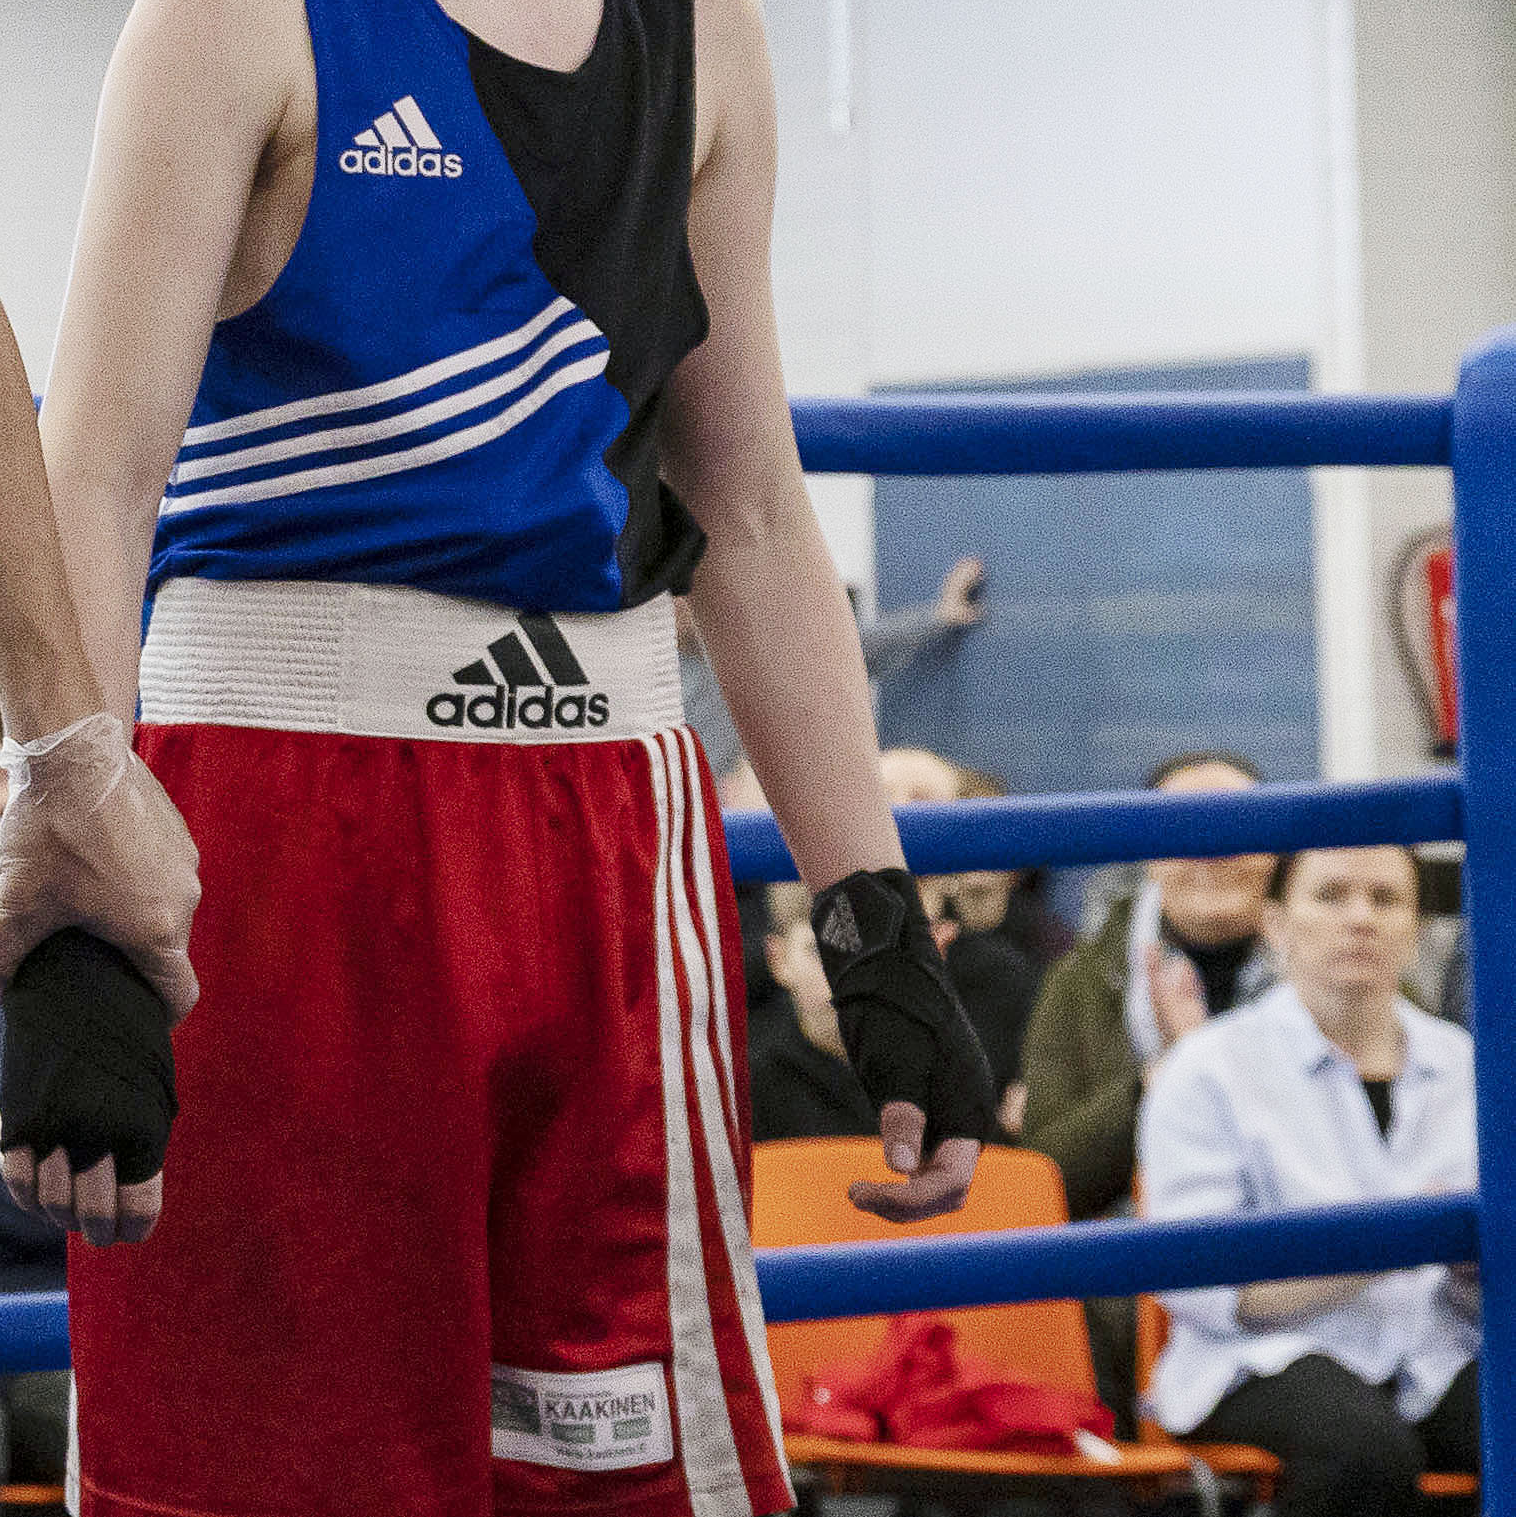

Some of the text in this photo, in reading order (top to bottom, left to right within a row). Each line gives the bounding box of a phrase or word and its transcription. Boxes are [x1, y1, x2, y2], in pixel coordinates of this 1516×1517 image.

[339, 146, 464, 179] adidas
[426, 684, 610, 729] adidas
[544, 1391, 656, 1421] KAAKINEN
